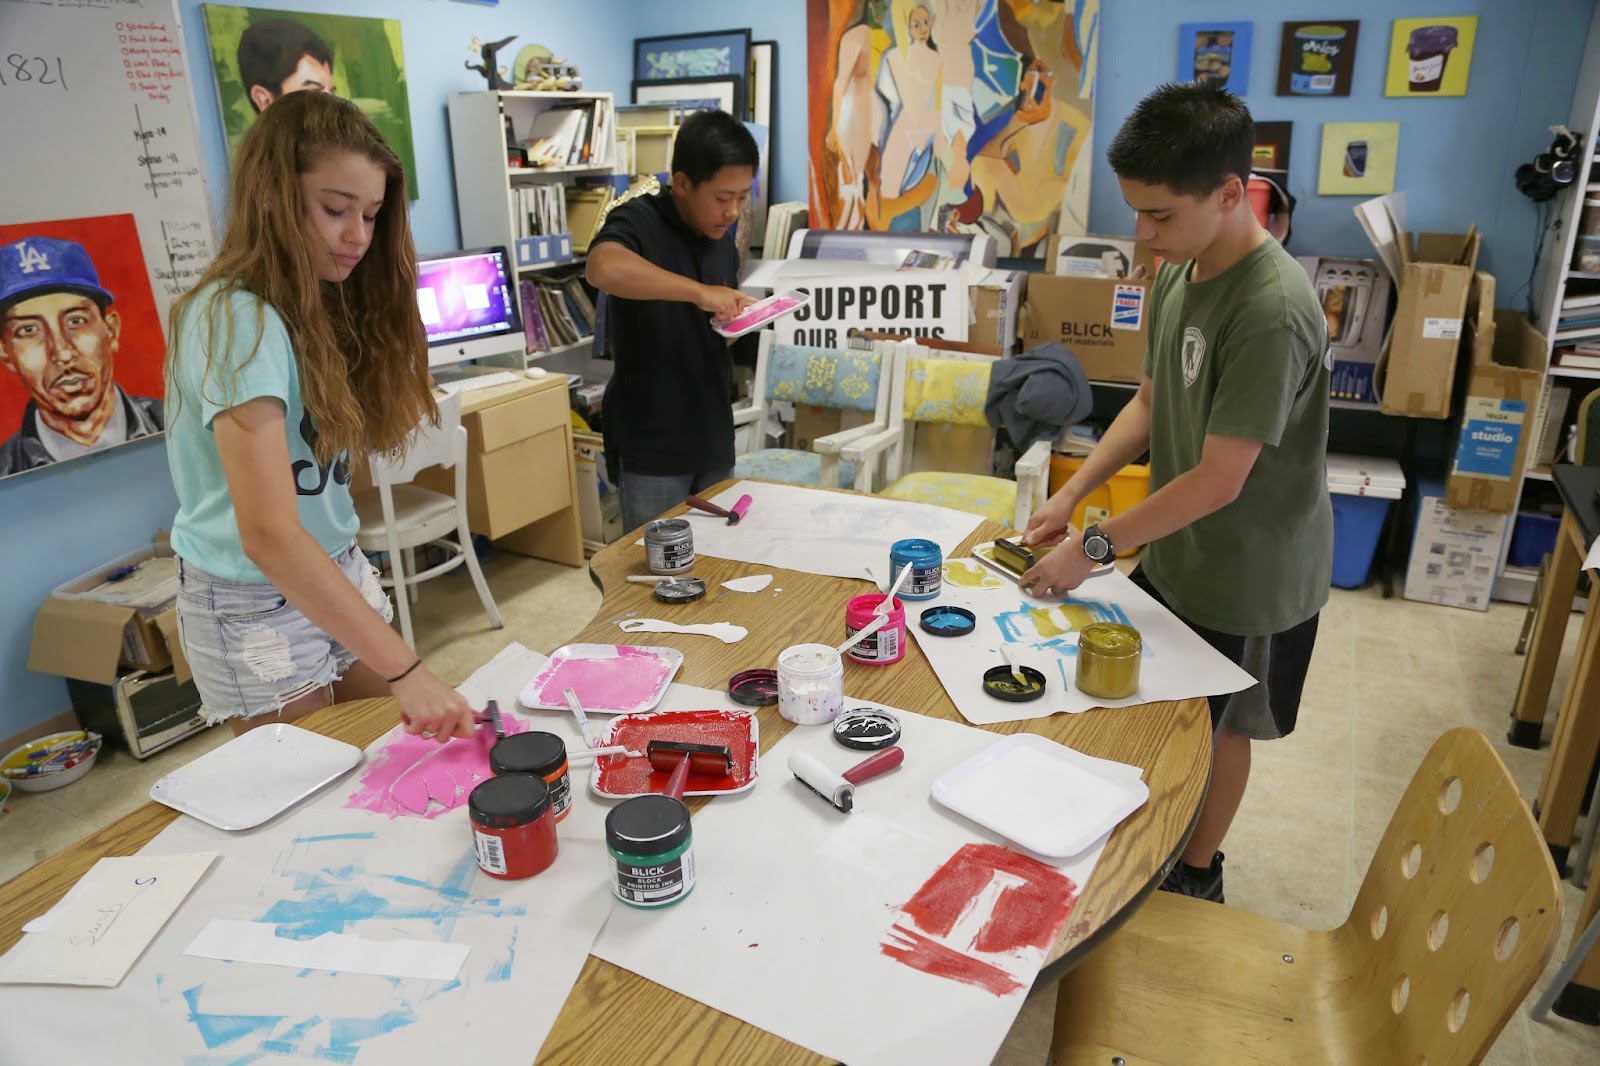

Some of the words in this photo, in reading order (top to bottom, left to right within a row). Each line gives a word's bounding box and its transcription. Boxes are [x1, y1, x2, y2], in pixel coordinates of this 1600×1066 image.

[15, 242, 51, 274] LA
[793, 284, 947, 321] SUPPORT
[1061, 322, 1114, 337] BLICK
[1075, 338, 1115, 347] materials
[1471, 431, 1513, 443] studio
[674, 542, 690, 551] BLICK
[925, 567, 940, 575] BLICK
[631, 866, 665, 876] BLICK
[620, 887, 628, 898] 16
